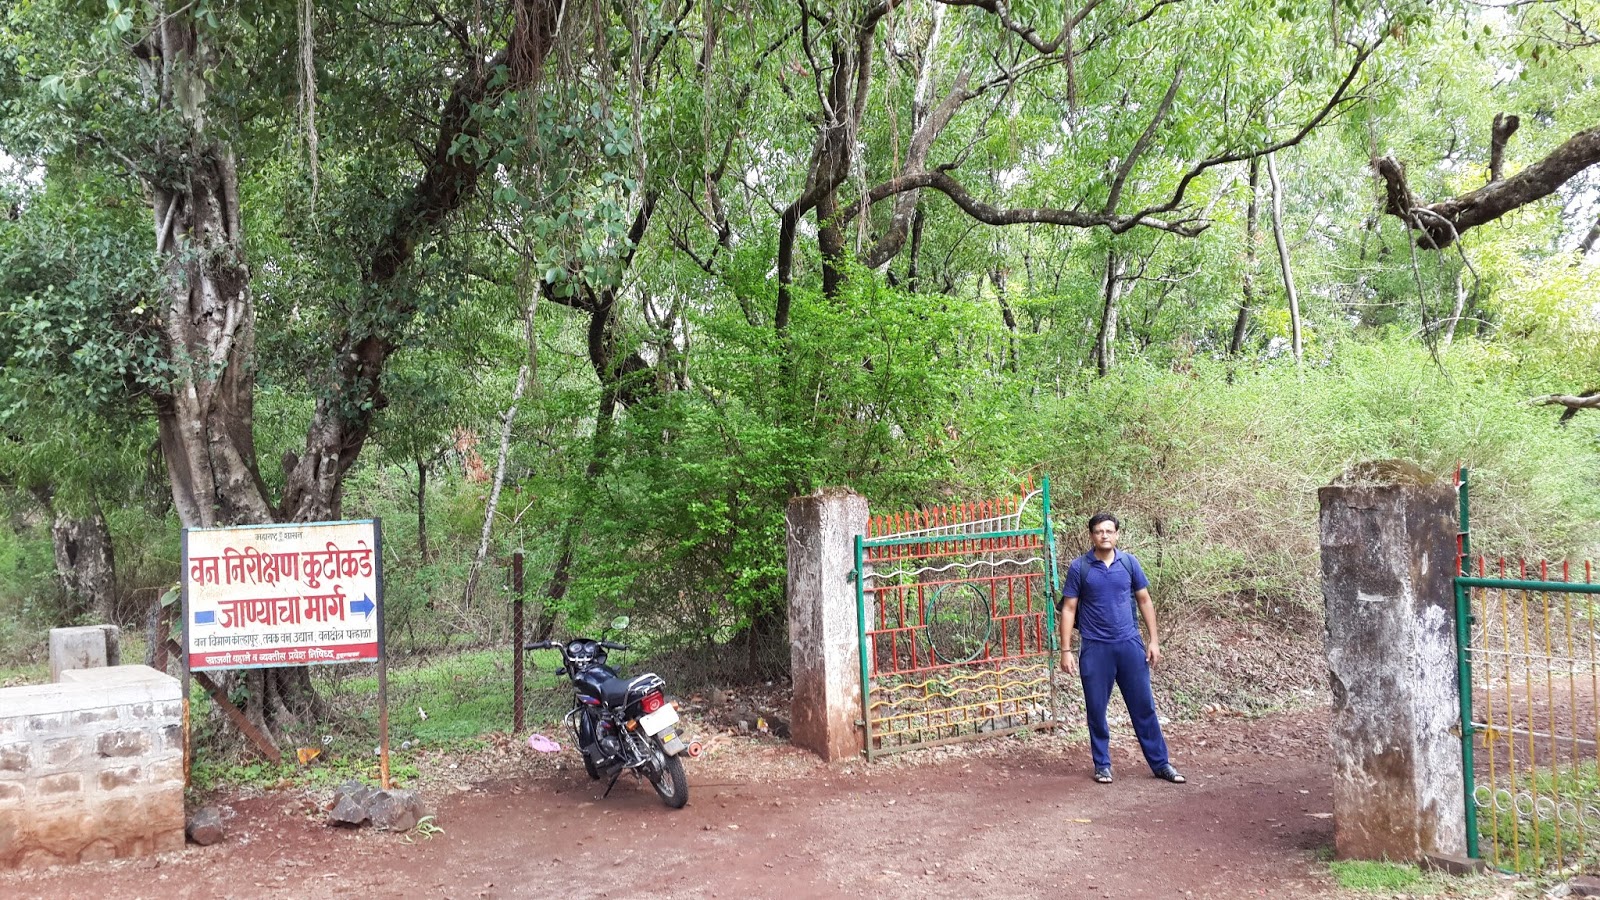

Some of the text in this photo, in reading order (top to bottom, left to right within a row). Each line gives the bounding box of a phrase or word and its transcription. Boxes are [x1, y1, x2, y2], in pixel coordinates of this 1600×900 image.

[189, 540, 372, 589] वन निरीक्षण कुटीकडे
[217, 584, 346, 628] जाण्याचा मार्ग
[194, 637, 207, 647] वन
[280, 632, 292, 643] वन
[318, 627, 344, 641] वनक्षेत्र
